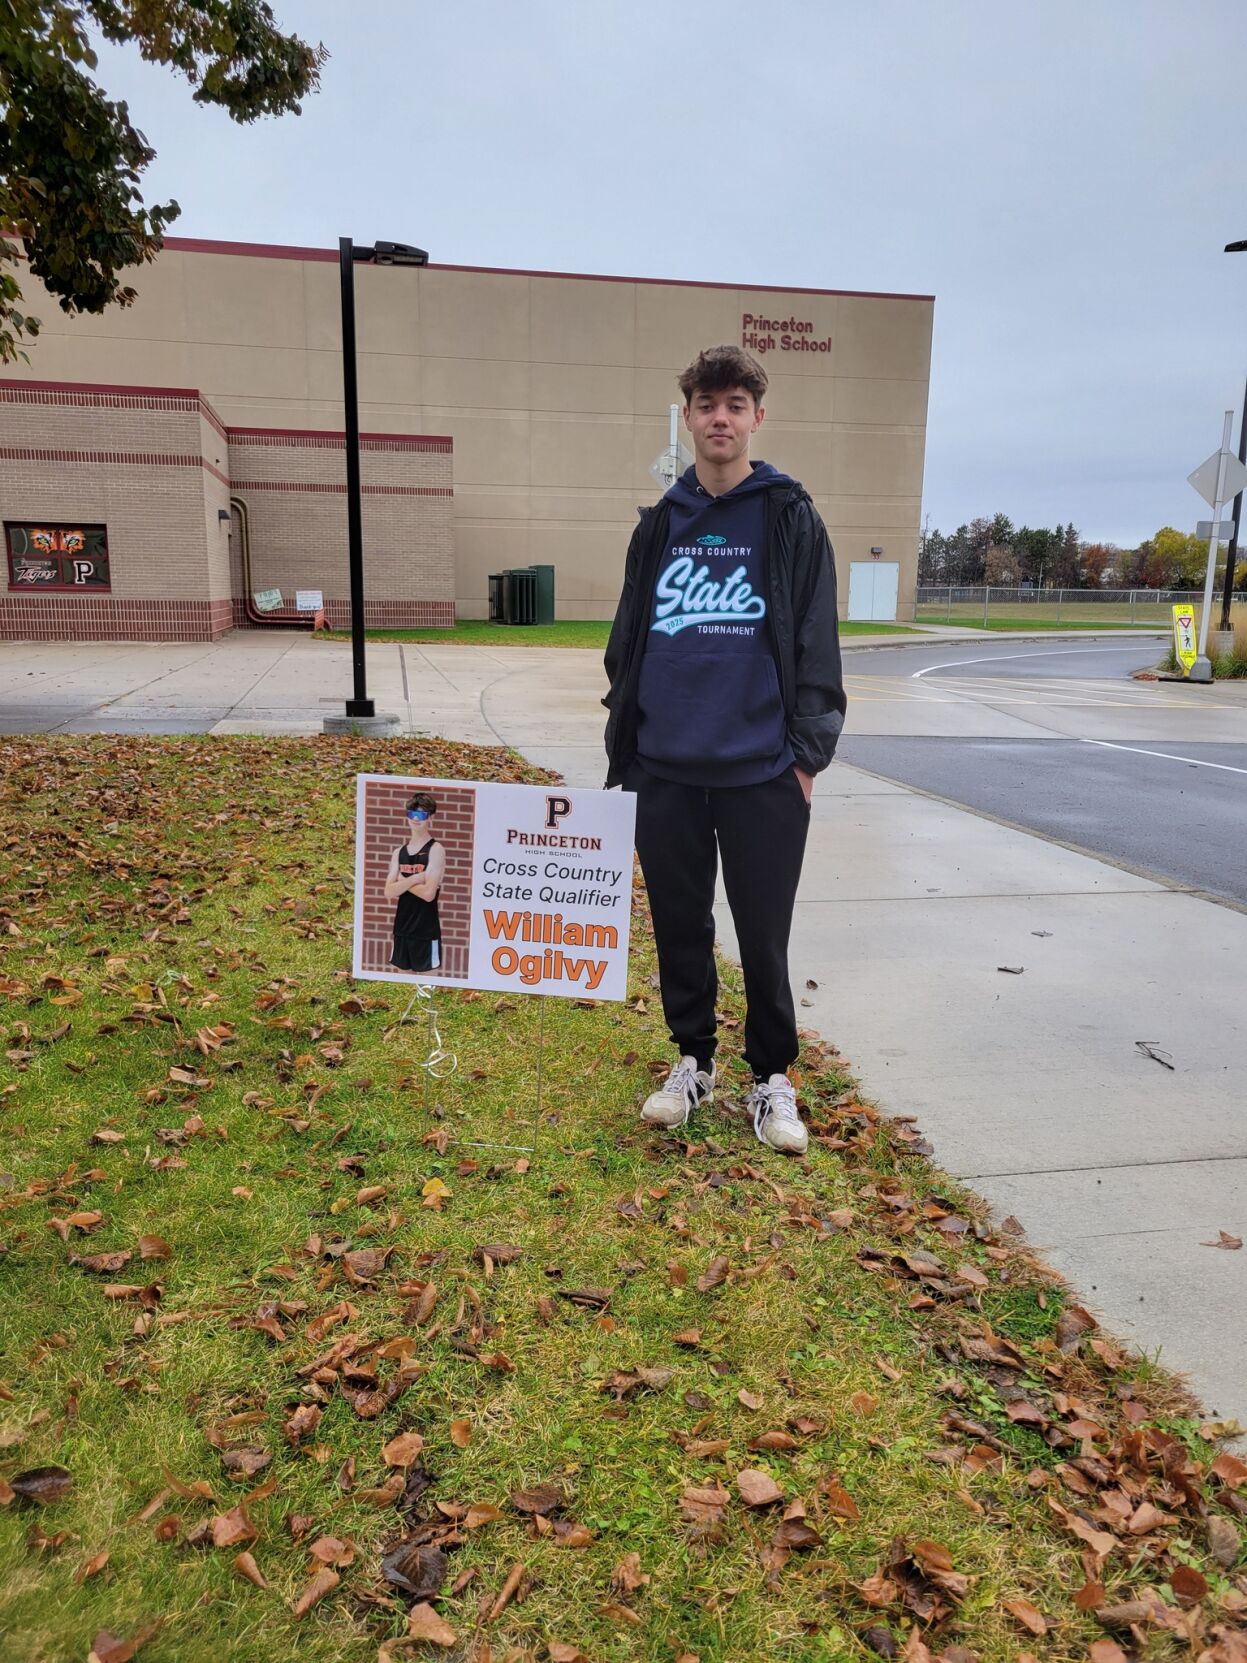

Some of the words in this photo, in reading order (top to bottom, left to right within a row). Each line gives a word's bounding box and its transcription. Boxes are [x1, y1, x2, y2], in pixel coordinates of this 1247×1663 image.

[742, 313, 813, 334] Princeton
[742, 332, 776, 354] High
[780, 334, 832, 353] School
[671, 546, 703, 556] CROSS
[707, 547, 752, 556] COUNTRY
[73, 560, 94, 584] P
[655, 556, 766, 619] State
[665, 617, 684, 631] 2025
[697, 625, 756, 636] TOURNAMENT
[544, 795, 573, 830] P
[548, 851, 583, 859] SCHOOL
[483, 858, 538, 877] Cross
[544, 862, 623, 887] Country
[482, 882, 533, 901] State
[539, 886, 621, 908] Qualifier
[483, 909, 619, 950] William
[491, 946, 609, 990] Ogilvy
